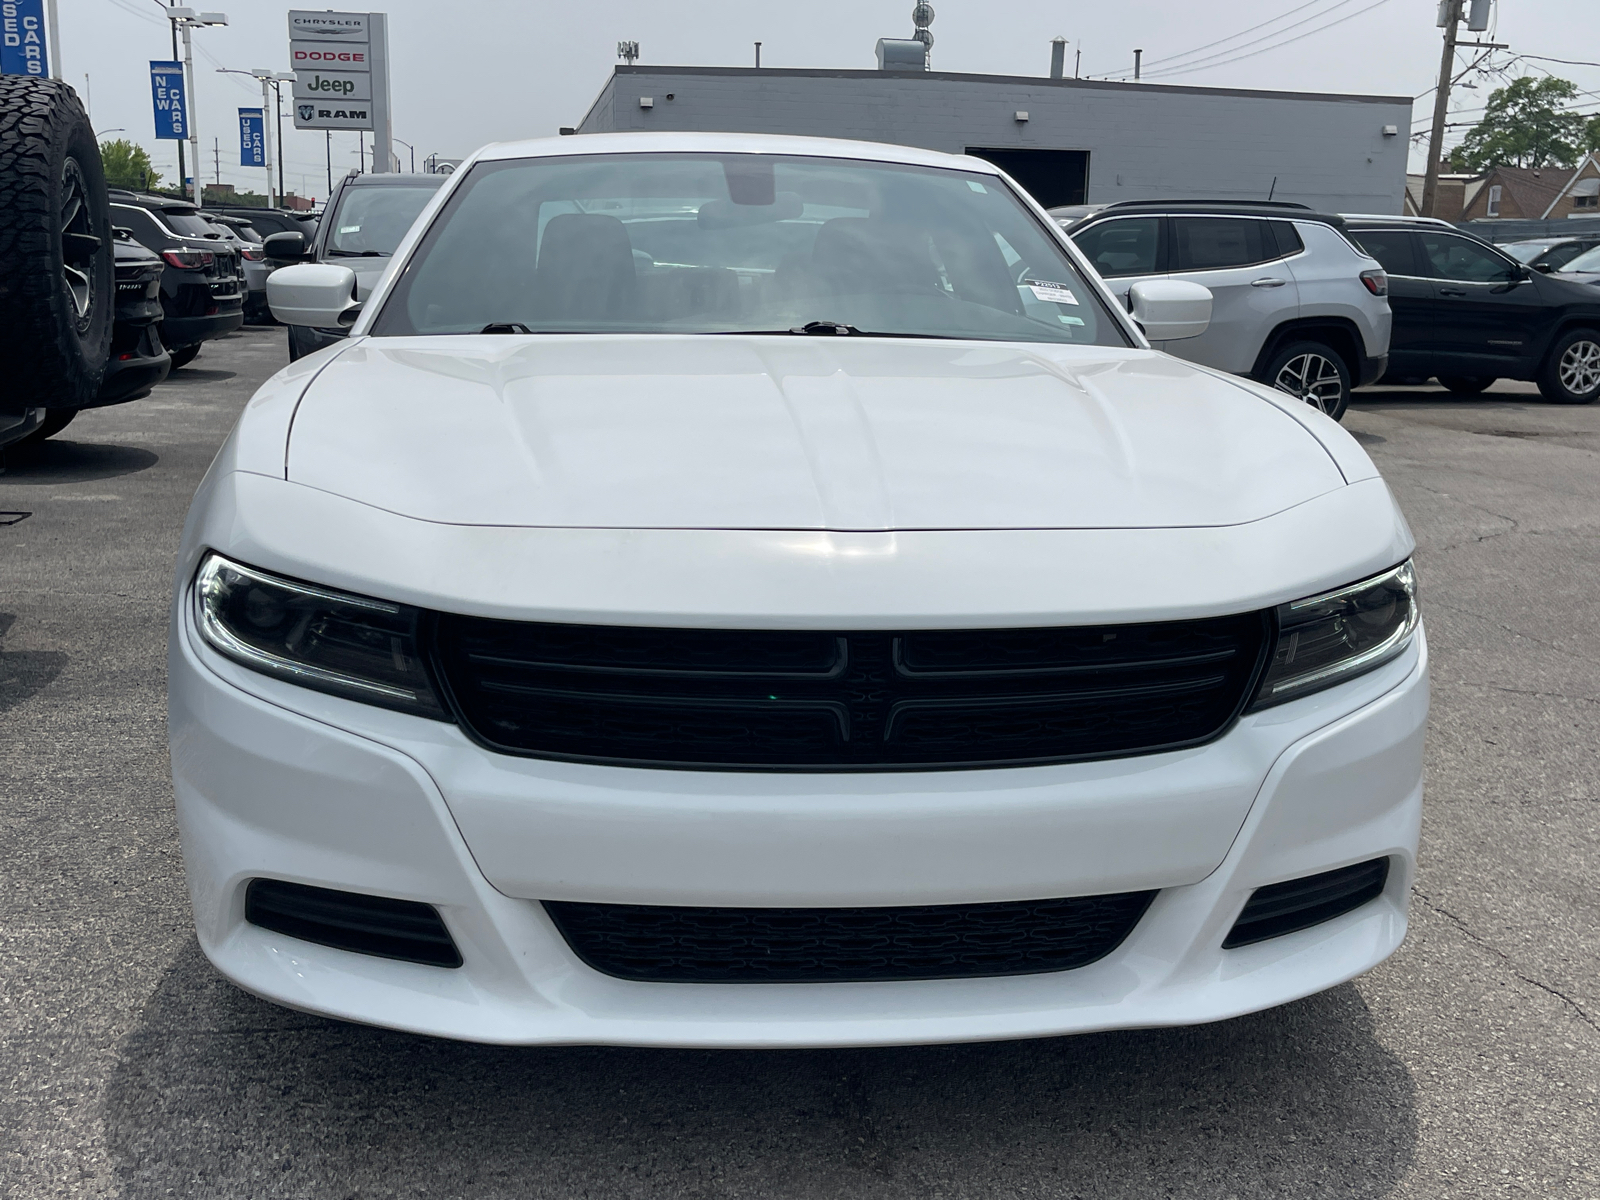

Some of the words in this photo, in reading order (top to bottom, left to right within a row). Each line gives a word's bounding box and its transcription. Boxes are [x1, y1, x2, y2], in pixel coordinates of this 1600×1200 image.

[294, 18, 361, 27] CHRYSLER
[3, 0, 20, 47] SED
[23, 16, 42, 74] CARS
[294, 51, 365, 62] DODGE
[307, 75, 355, 96] Jeep
[155, 76, 170, 110] NEW
[170, 89, 183, 133] CARS
[318, 109, 367, 119] RAM
[242, 119, 252, 149] USED
[252, 132, 262, 162] CARS
